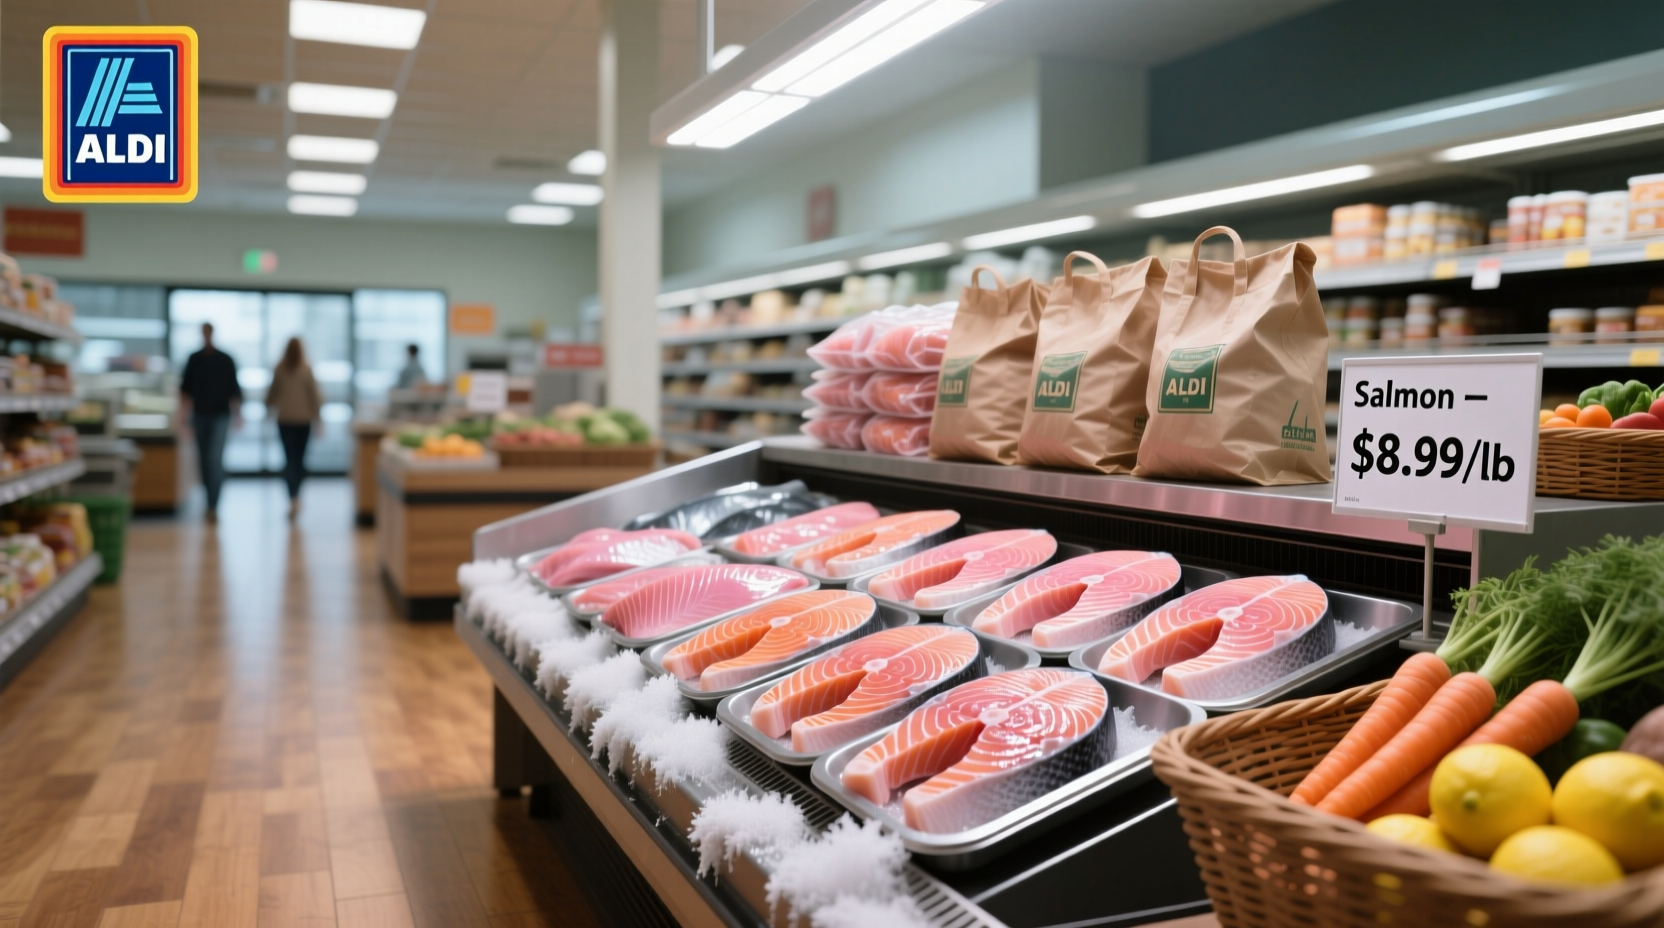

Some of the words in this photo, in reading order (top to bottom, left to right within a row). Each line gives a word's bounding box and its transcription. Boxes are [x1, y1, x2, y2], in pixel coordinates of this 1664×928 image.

[1037, 380, 1071, 397] ALDI
[1165, 377, 1207, 396] ALDI
[1354, 379, 1454, 409] Salmon
[1350, 427, 1515, 484] $8.99/lb
